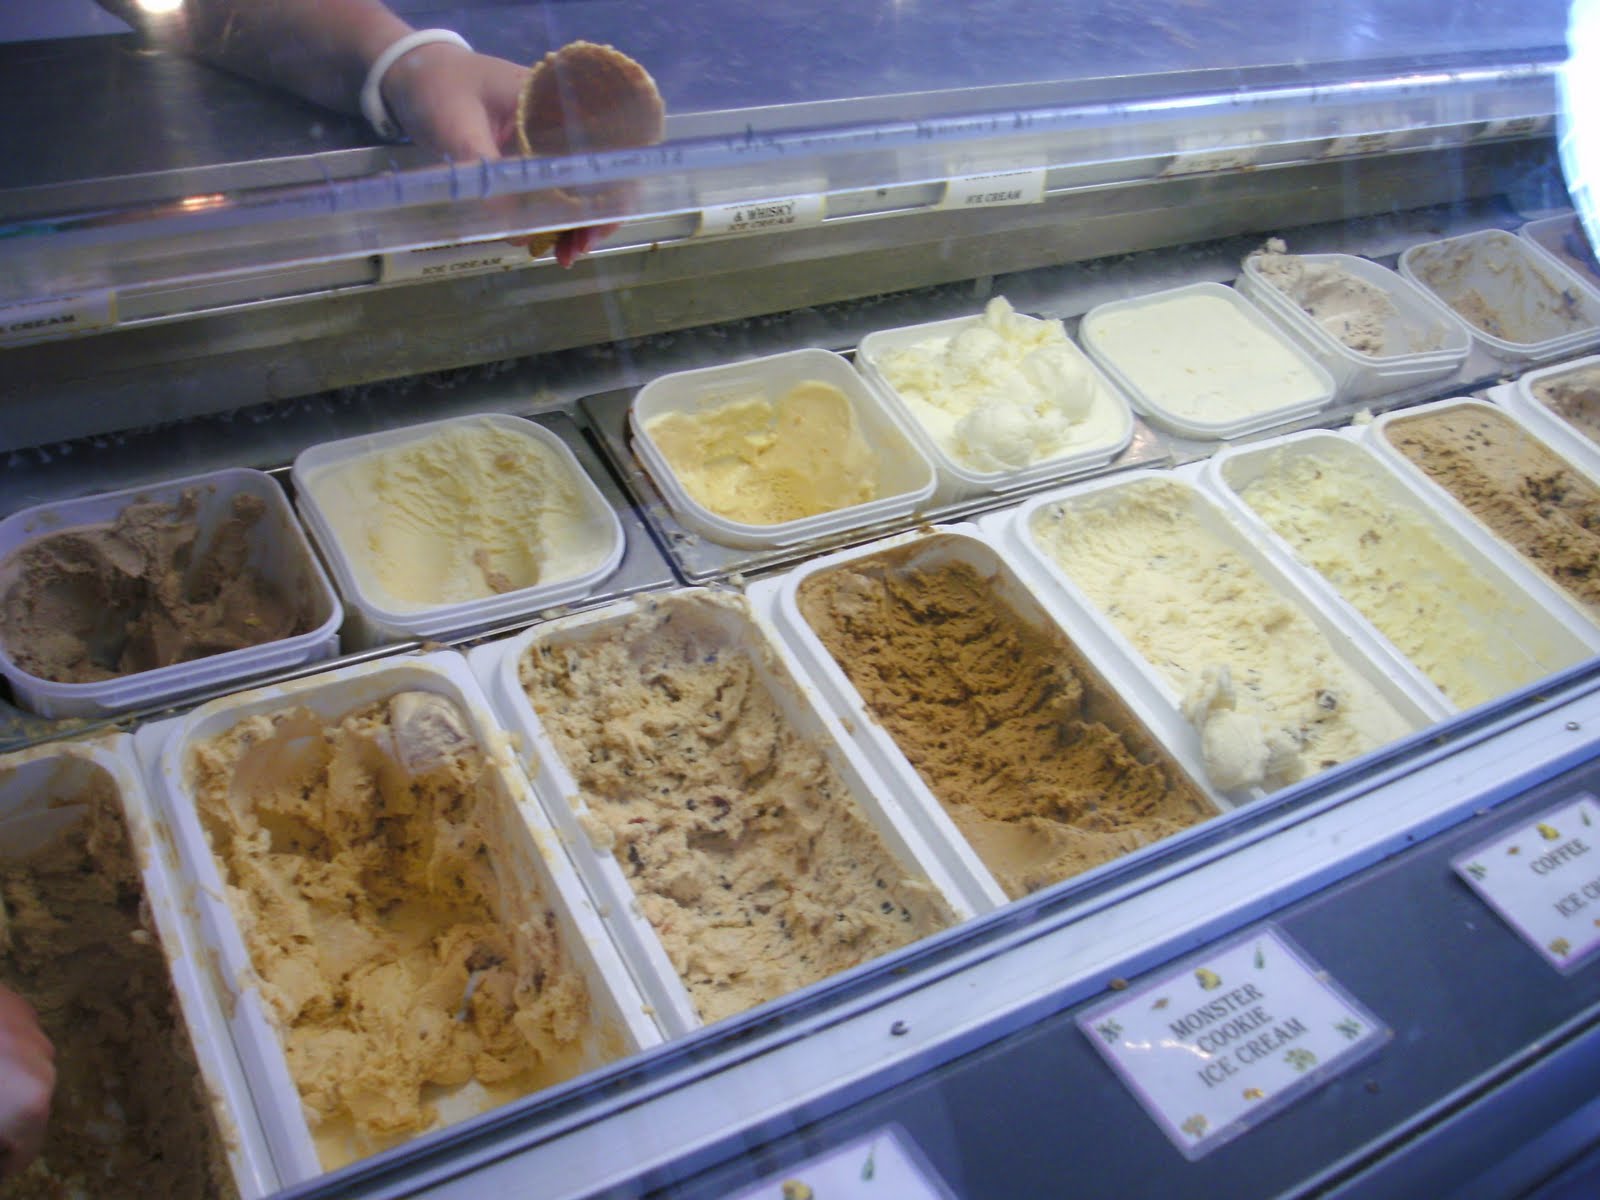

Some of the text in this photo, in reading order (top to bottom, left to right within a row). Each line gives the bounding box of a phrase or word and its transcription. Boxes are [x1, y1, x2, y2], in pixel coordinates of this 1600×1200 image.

[746, 202, 796, 220] WHISKY
[984, 189, 1023, 202] CREAM
[1530, 838, 1591, 875] COFFEE
[1553, 892, 1589, 919] ICE
[1168, 983, 1265, 1040] MONSTER
[1196, 1006, 1274, 1054] COOKIE
[1197, 1016, 1309, 1089] ICE CREAM
